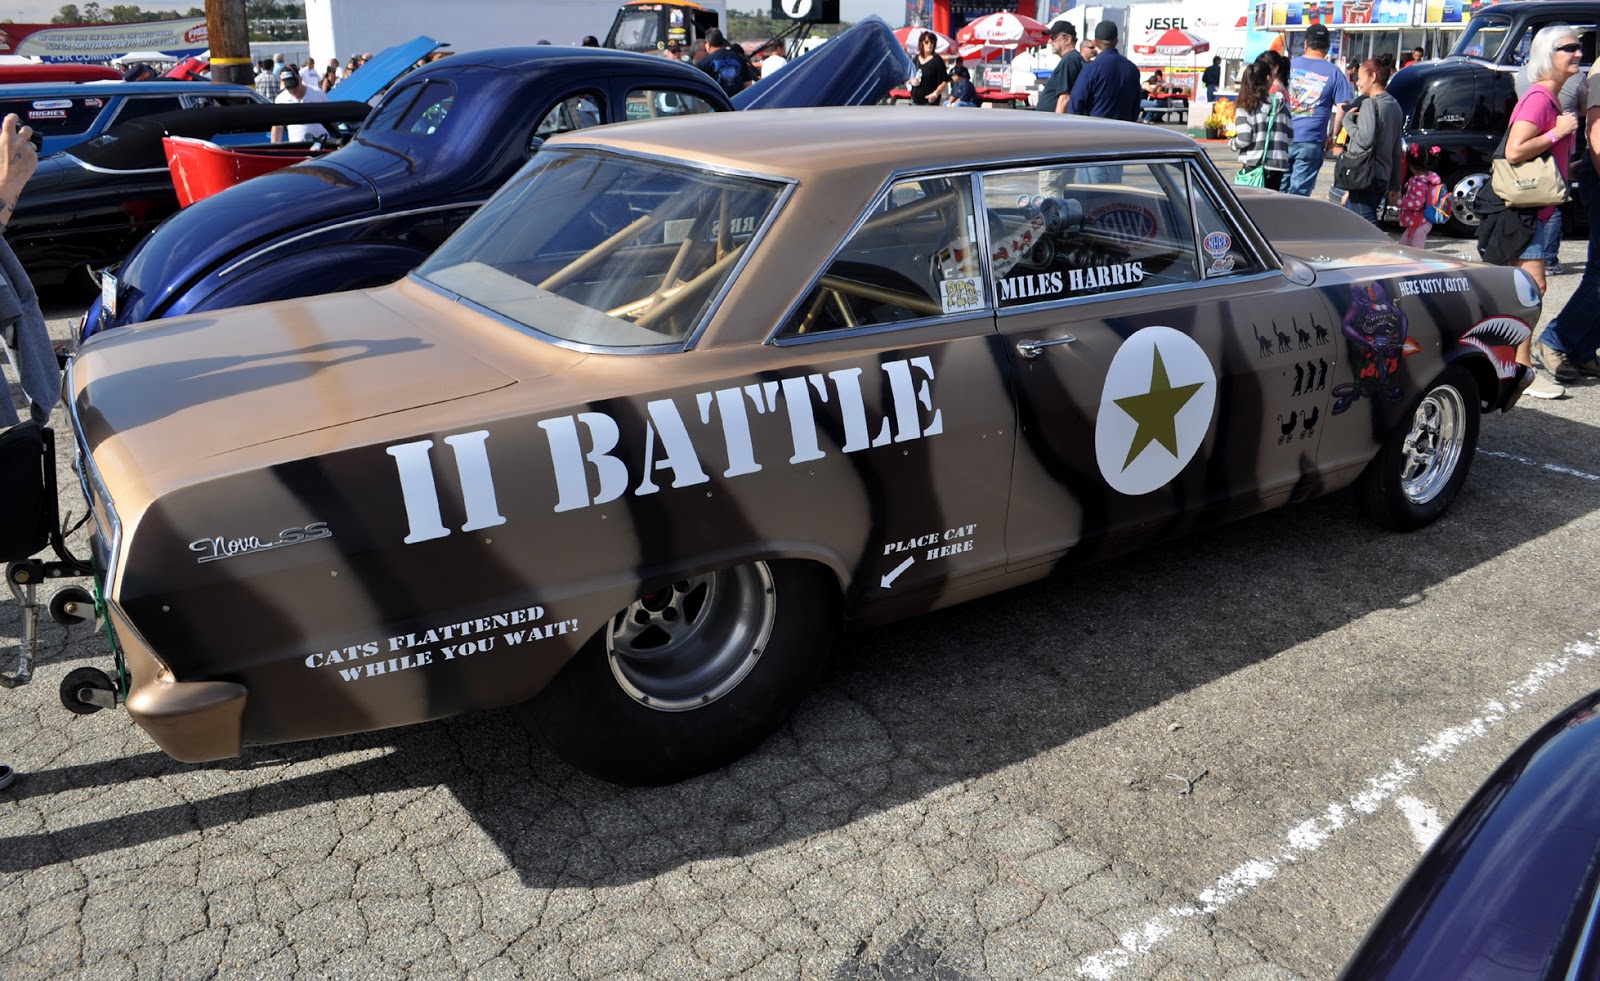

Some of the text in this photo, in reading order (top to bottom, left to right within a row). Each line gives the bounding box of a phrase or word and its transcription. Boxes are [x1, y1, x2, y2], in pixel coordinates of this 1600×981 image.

[1146, 18, 1188, 30] JESEL
[1208, 236, 1227, 250] NHRA
[999, 262, 1144, 301] MILES HARRIS
[1399, 277, 1470, 297] HERE KITTY, KITTY!
[386, 355, 944, 544] II BATTLE
[189, 521, 331, 557] Nova SS
[883, 523, 977, 556] PLACE CAT
[926, 539, 974, 561] HERE
[305, 605, 545, 669] CATS FLATTENED
[338, 618, 579, 682] WHILE YOU WAIT!
